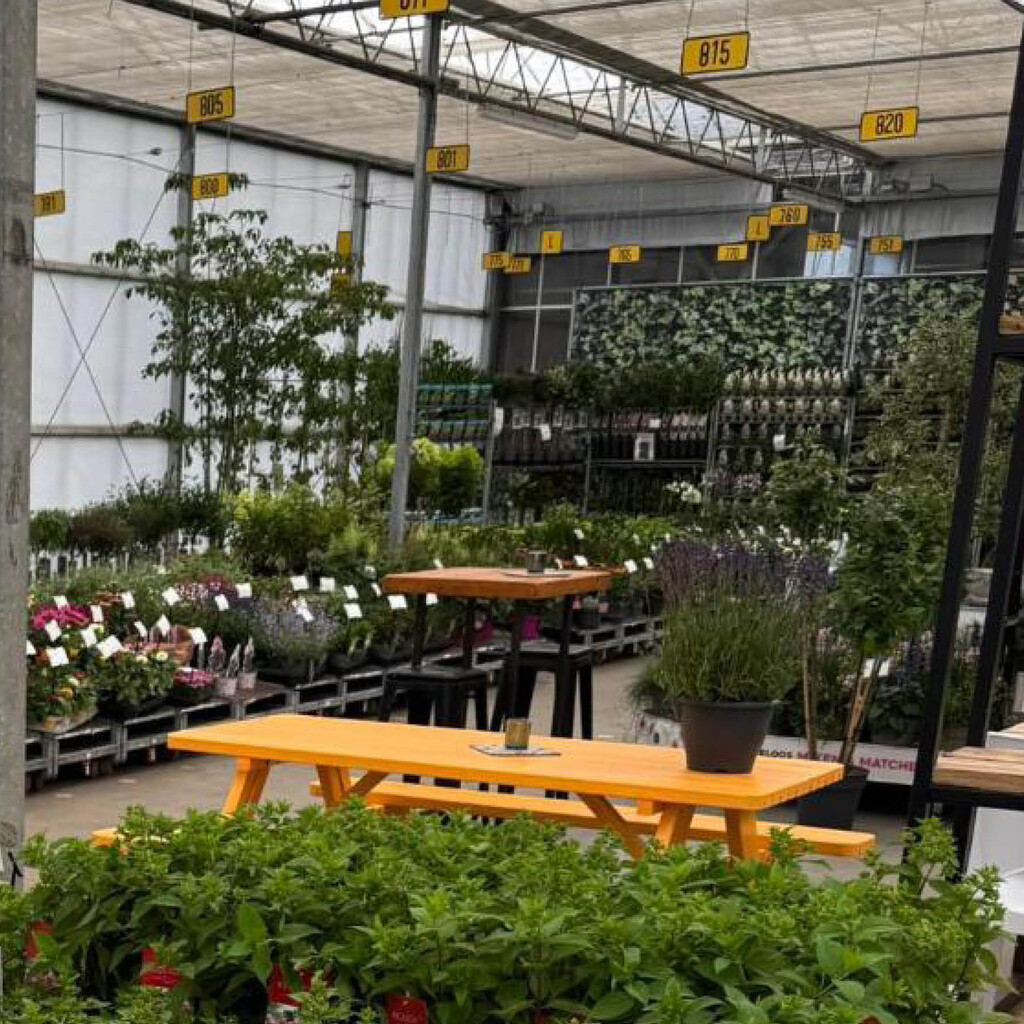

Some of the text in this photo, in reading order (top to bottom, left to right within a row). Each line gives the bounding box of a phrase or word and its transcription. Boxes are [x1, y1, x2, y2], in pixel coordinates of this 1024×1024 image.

[698, 39, 731, 68] 815
[199, 95, 224, 117] 805
[875, 112, 904, 136] 820
[437, 149, 456, 169] 801
[779, 207, 801, 223] 760
